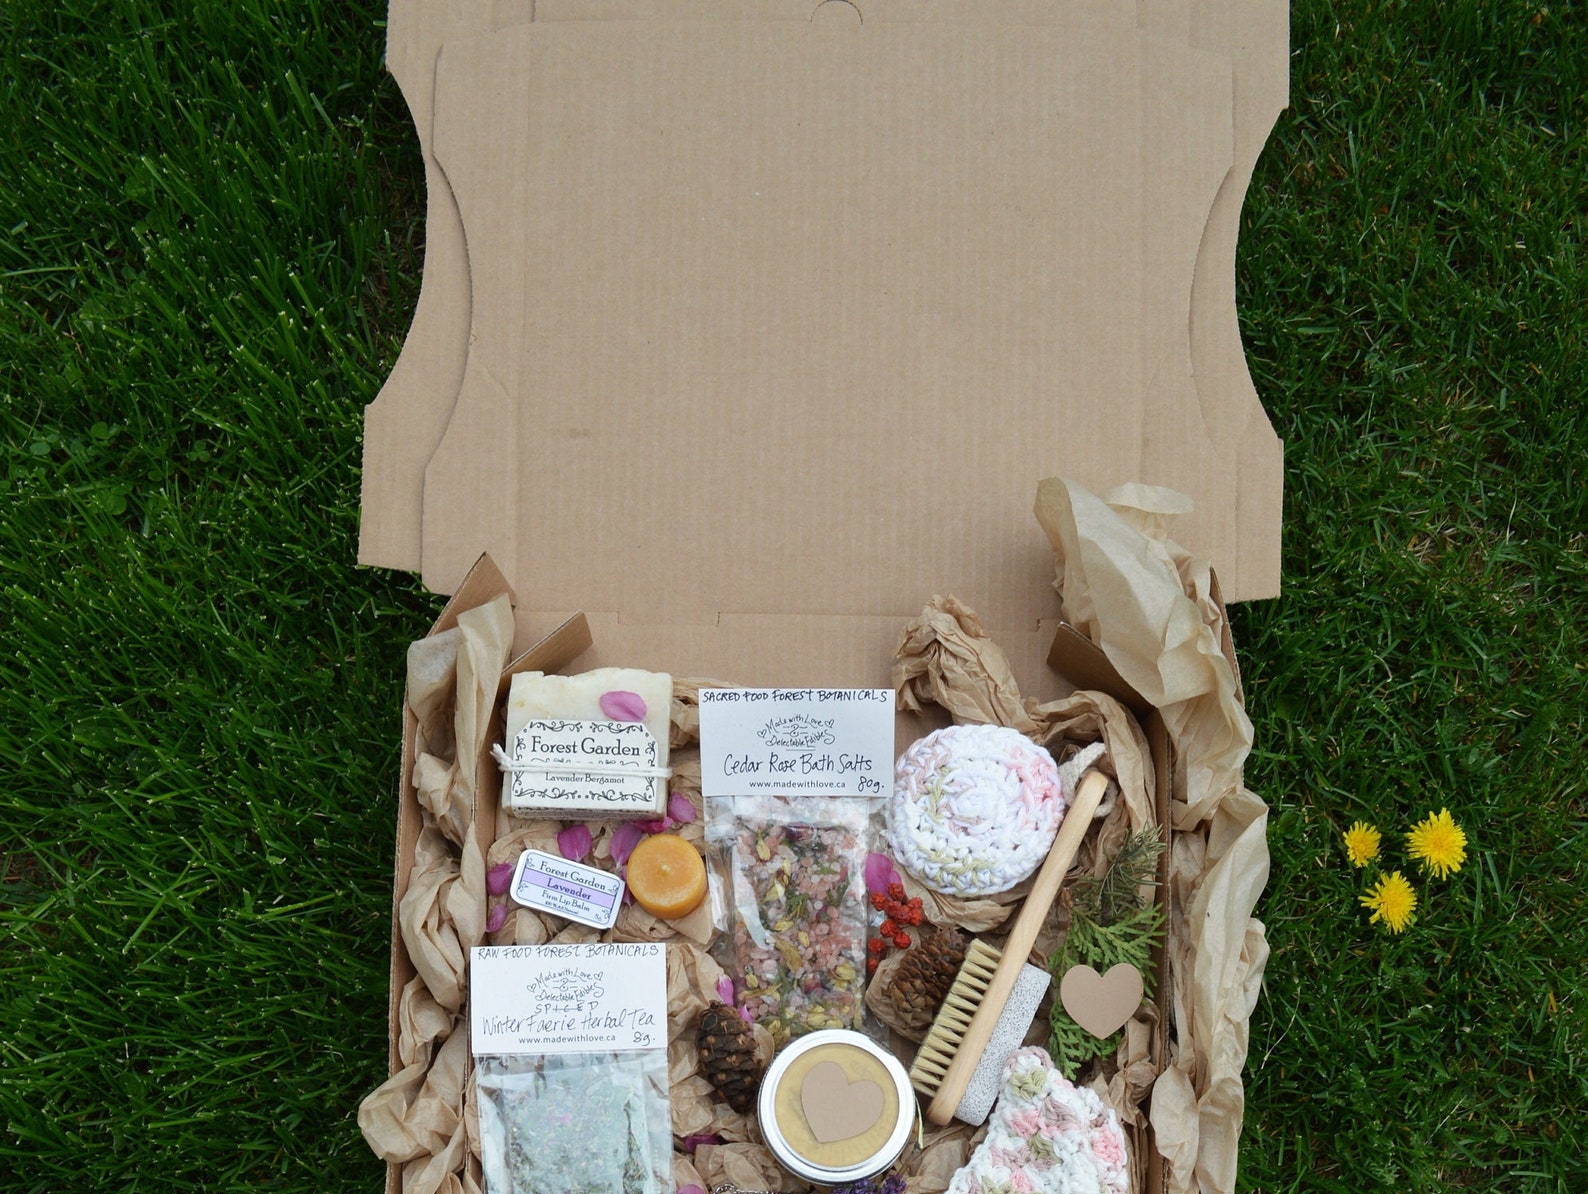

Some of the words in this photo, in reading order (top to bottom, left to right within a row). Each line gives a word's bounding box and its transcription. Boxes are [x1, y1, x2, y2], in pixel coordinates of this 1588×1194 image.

[703, 692, 740, 702] SACRED
[743, 691, 768, 701] FOOD
[773, 690, 812, 701] FOREST
[818, 690, 887, 702] BOTANICALS
[766, 718, 787, 734] Made
[788, 714, 804, 723] with
[804, 714, 823, 729] Love
[531, 736, 578, 753] Forest
[581, 737, 640, 756] Garden
[765, 735, 804, 747] Delectable
[724, 754, 763, 776] Cedar
[769, 753, 797, 773] Rose
[800, 752, 834, 774] Bath
[837, 754, 872, 772] Salts
[546, 773, 584, 782] Lavender
[585, 774, 625, 784] Bergamot
[749, 780, 846, 788] www.madewithlove.ca
[540, 861, 568, 878] Forest
[570, 871, 606, 890] Garden
[547, 878, 592, 900] Lavender
[542, 890, 558, 901] Firm
[559, 895, 570, 906] Lip
[572, 900, 590, 912] Balm
[478, 947, 499, 960] RAW
[503, 947, 531, 959] FOOD
[536, 945, 581, 958] FOREST
[585, 944, 659, 958] BOTANICALS
[536, 972, 556, 989] Made
[558, 968, 573, 977] with
[573, 968, 593, 982] Love
[535, 990, 574, 1001] Delectable
[483, 1016, 524, 1036] Winter
[526, 1014, 576, 1033] Faerie
[581, 1009, 627, 1030] Herbal
[628, 1009, 656, 1027] Tea
[519, 1034, 616, 1044] www.madewithlove.ca
